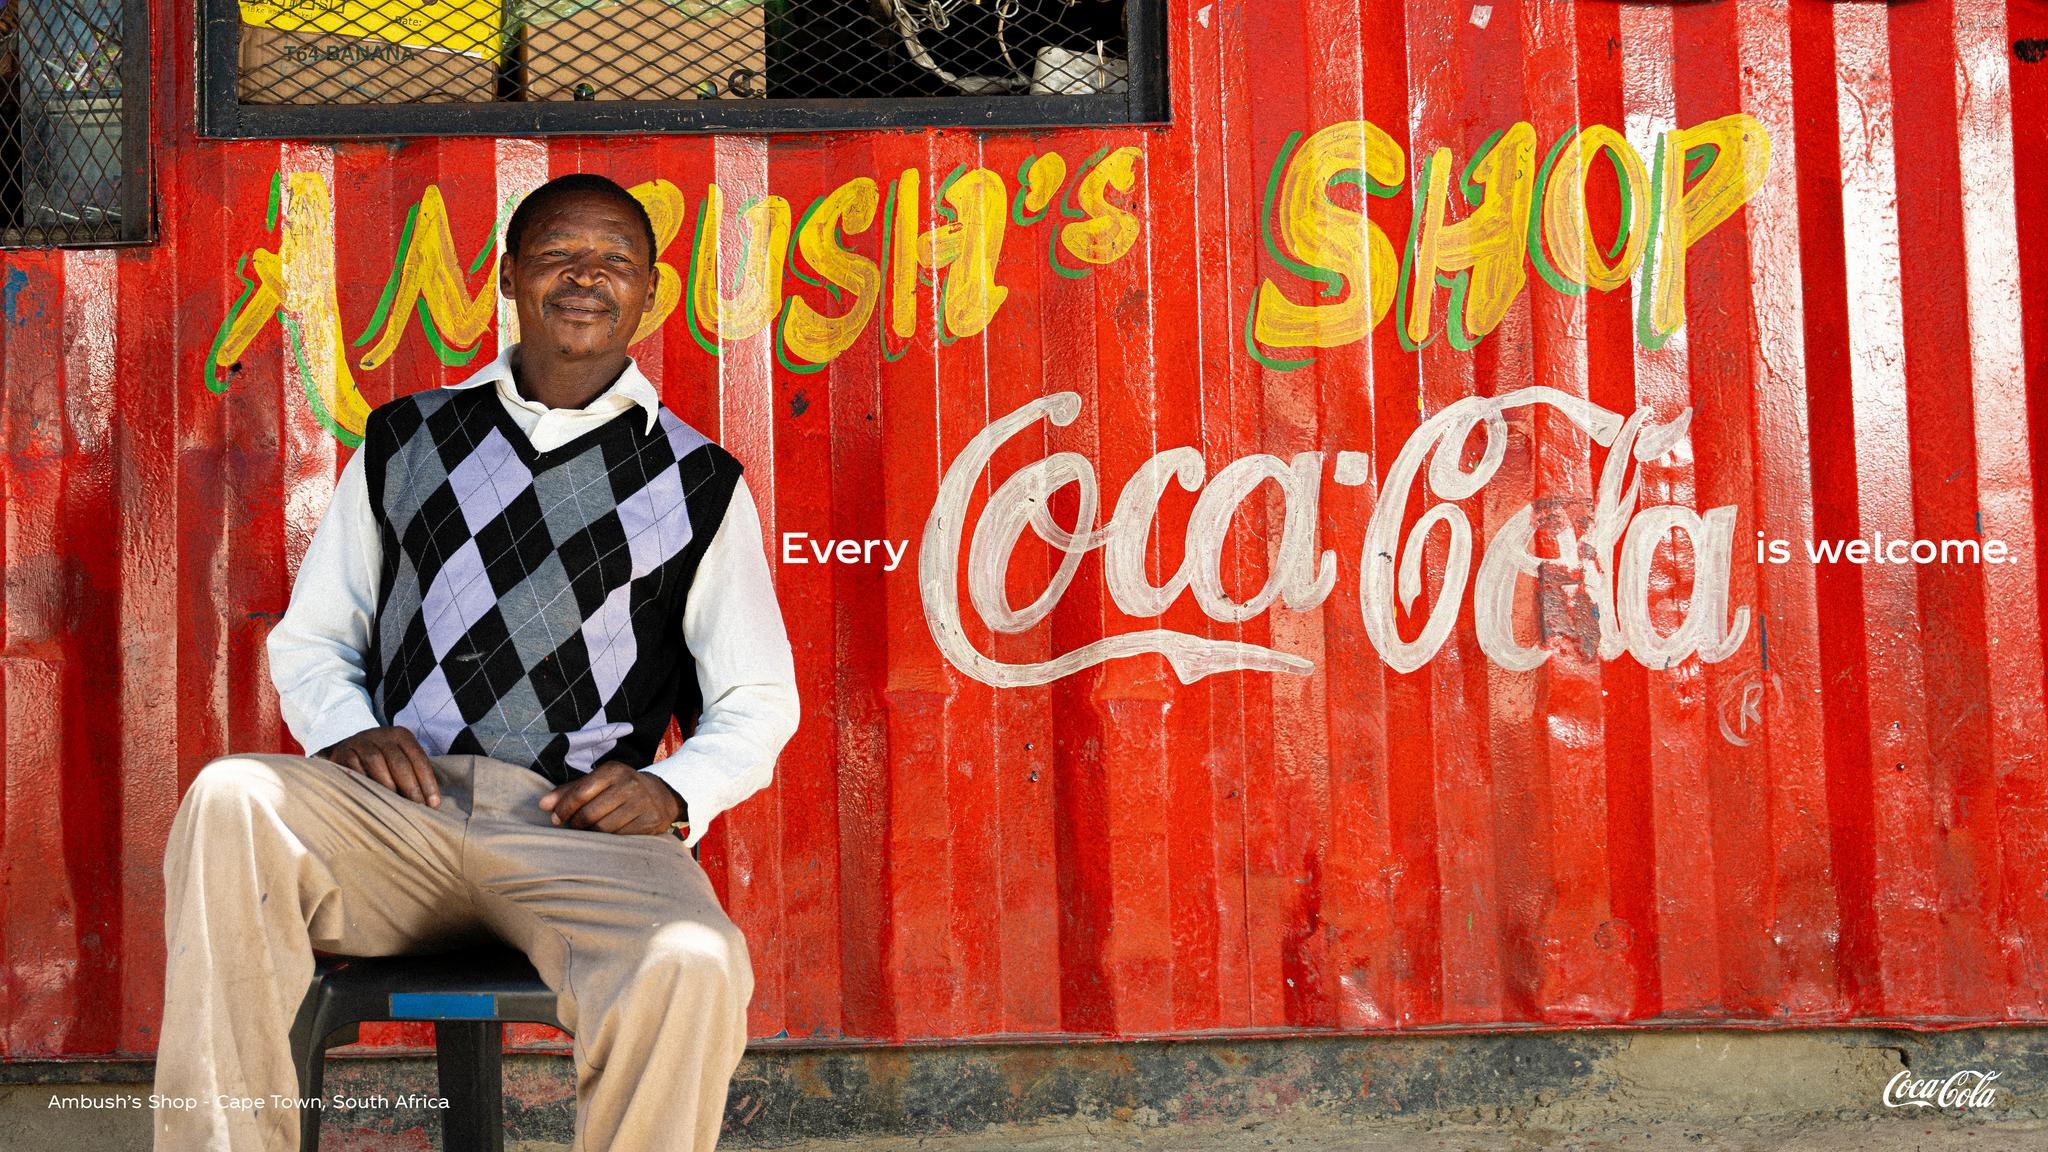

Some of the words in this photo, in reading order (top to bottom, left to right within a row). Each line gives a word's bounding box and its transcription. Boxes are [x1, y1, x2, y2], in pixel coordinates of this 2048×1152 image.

[283, 45, 319, 61] T64
[326, 45, 416, 61] BANANA
[1246, 114, 1772, 371] SHOP
[918, 386, 1751, 688] Coca-Cola
